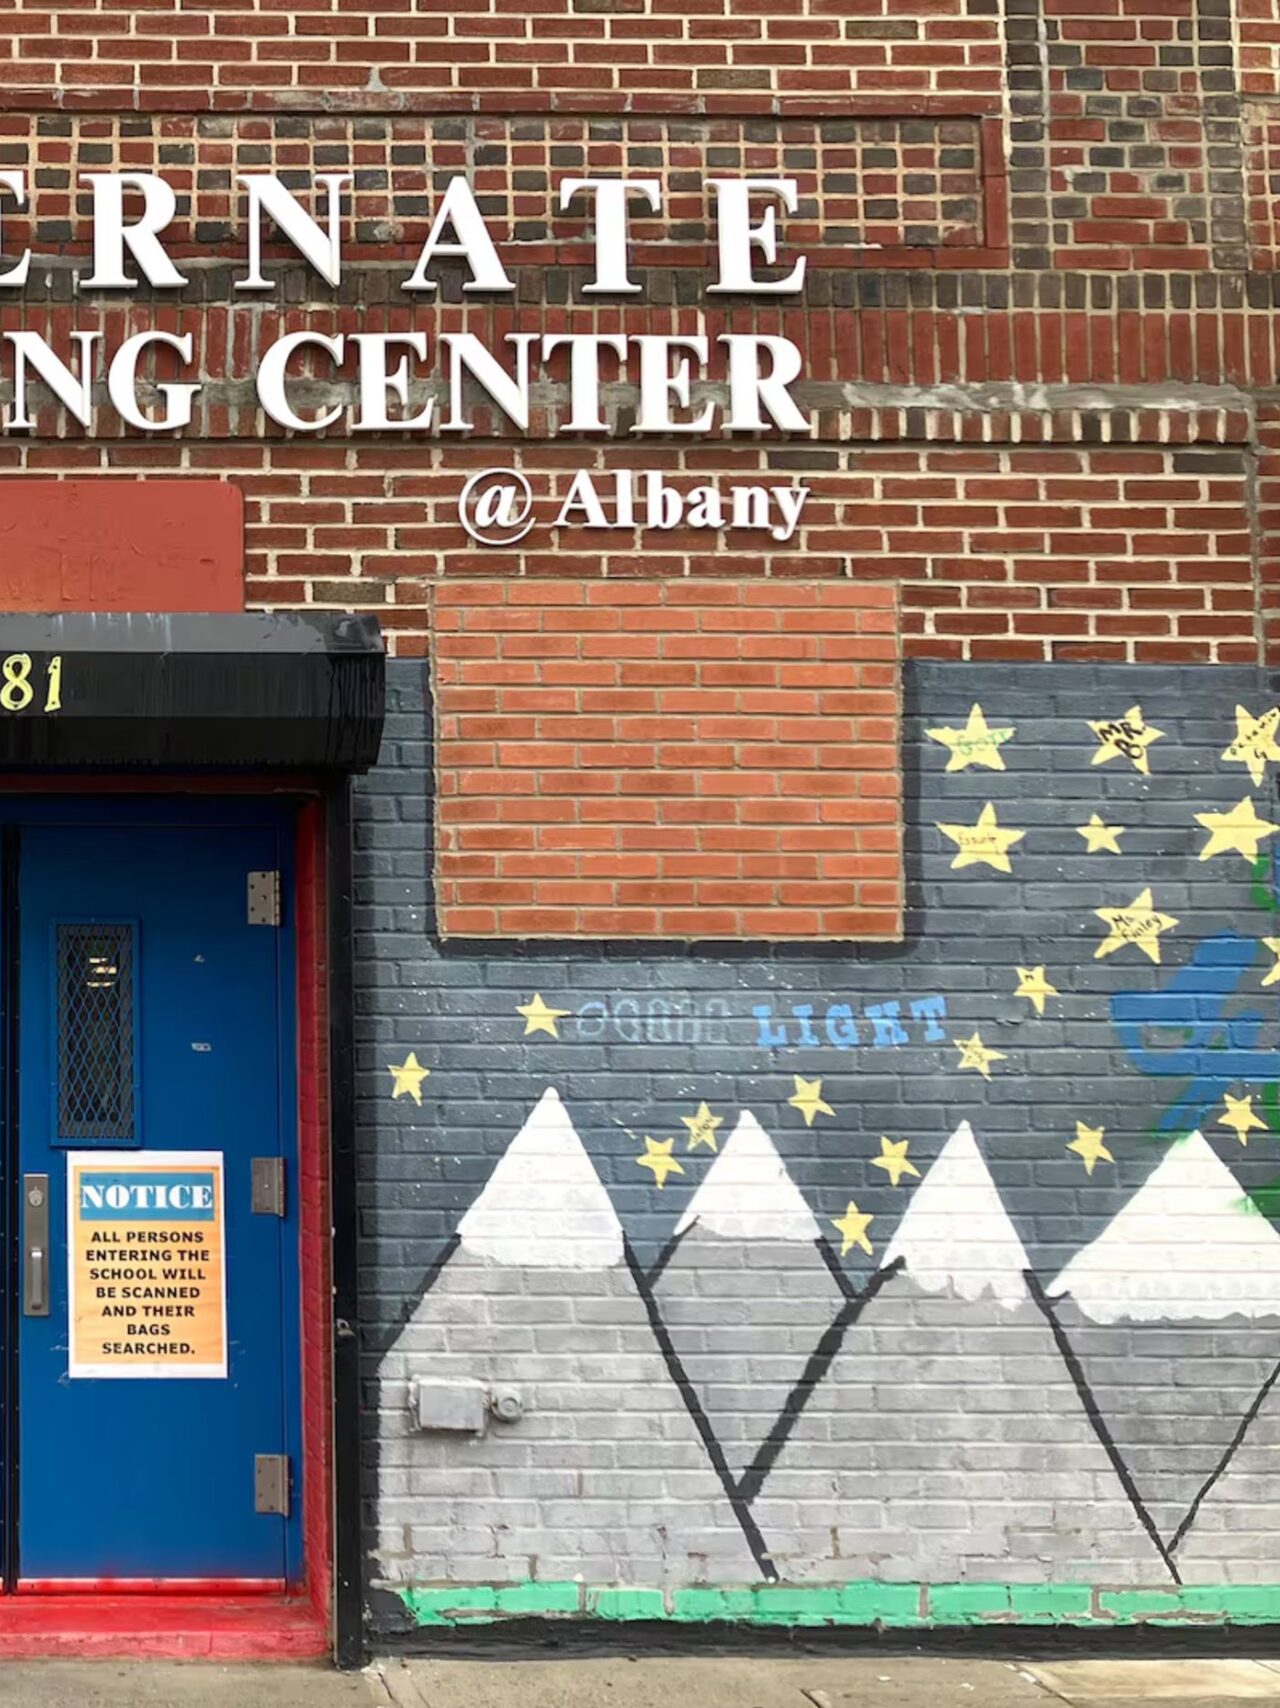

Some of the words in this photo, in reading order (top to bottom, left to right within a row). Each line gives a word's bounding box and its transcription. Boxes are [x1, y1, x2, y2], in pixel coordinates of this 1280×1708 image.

[256, 330, 813, 433] CENTER
[458, 467, 536, 545] @
[552, 467, 811, 541] Albany
[751, 996, 949, 1049] LIGHT
[80, 1184, 213, 1210] NOTICE
[91, 1231, 120, 1243] ALL
[126, 1231, 204, 1243] PERSONS
[86, 1249, 172, 1261] ENTERING
[177, 1249, 210, 1261] THE
[89, 1268, 157, 1280] SCHOOL
[162, 1268, 206, 1280] WILL
[96, 1287, 116, 1299] BE
[121, 1287, 200, 1299] SCANNED
[101, 1305, 137, 1317] AND
[142, 1305, 195, 1317] THEIR
[127, 1324, 171, 1336] BAGS
[102, 1342, 195, 1355] SEARCHED.
